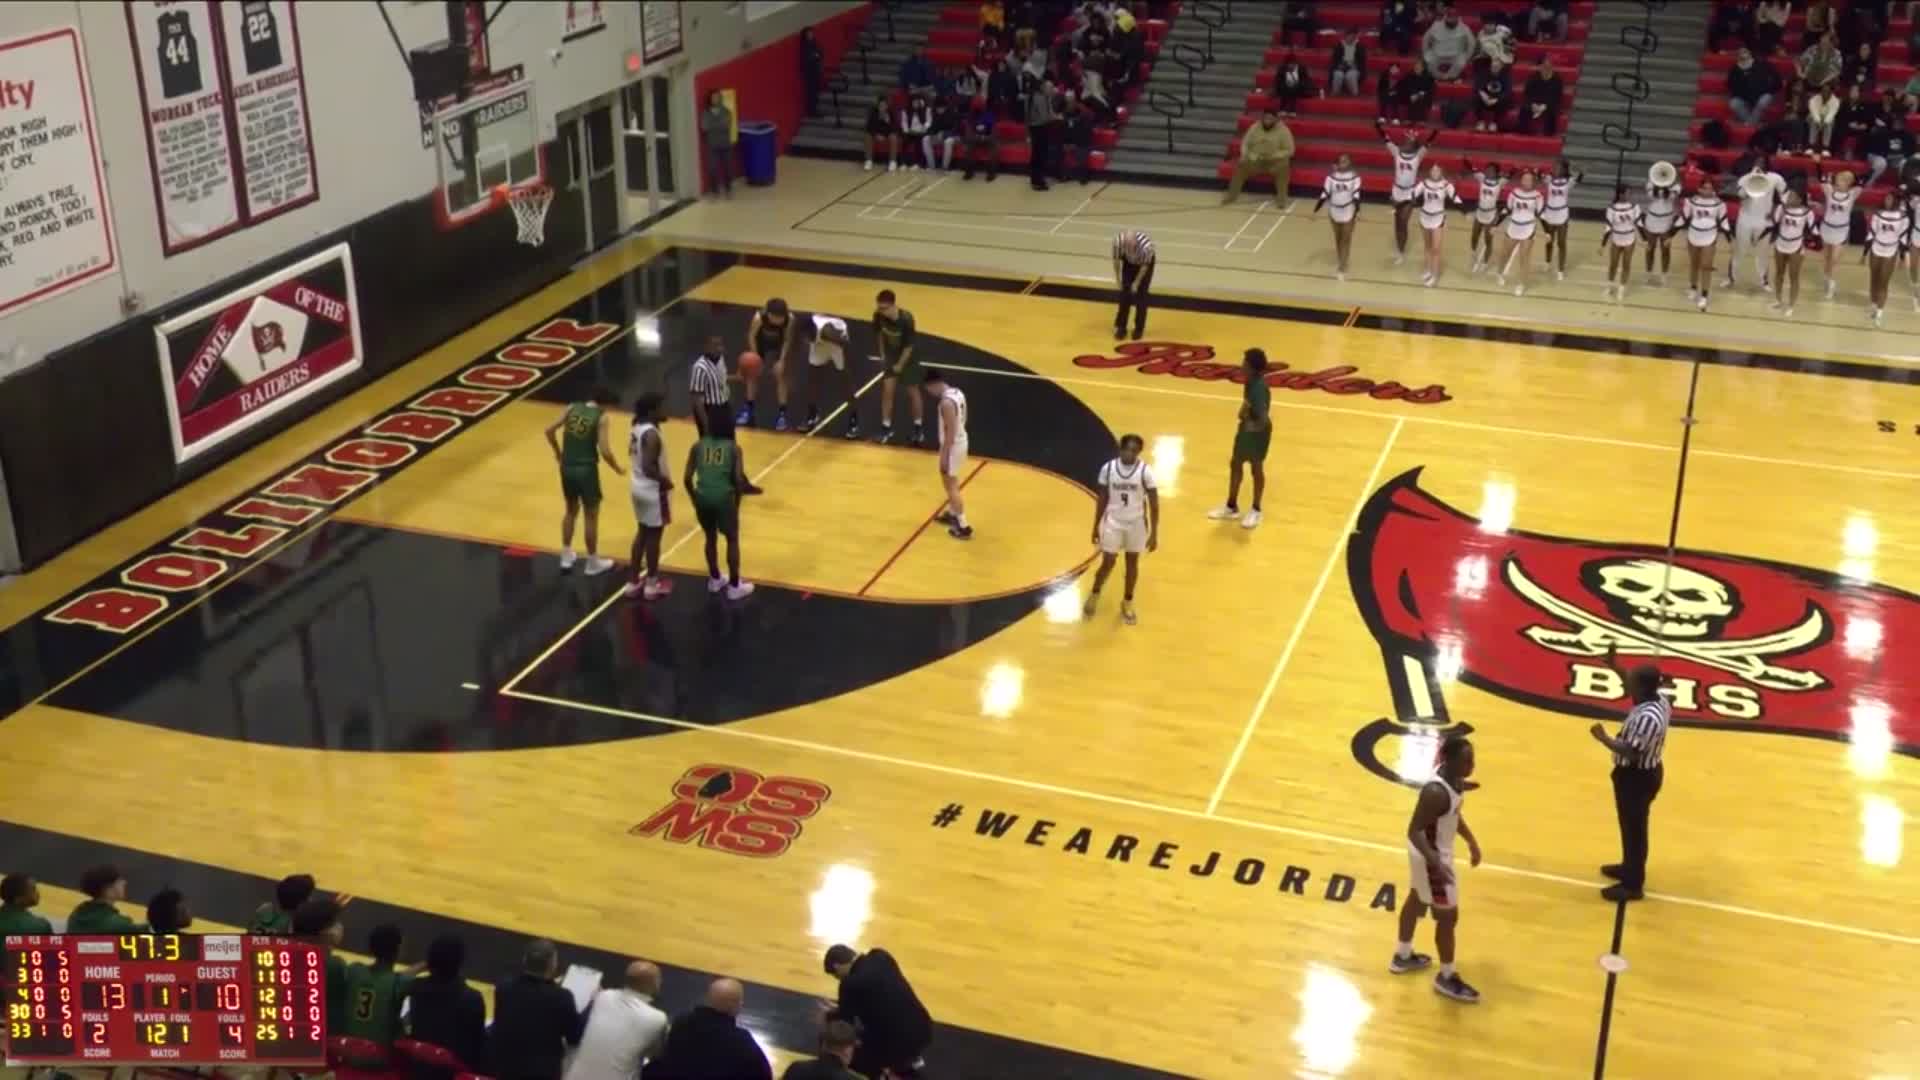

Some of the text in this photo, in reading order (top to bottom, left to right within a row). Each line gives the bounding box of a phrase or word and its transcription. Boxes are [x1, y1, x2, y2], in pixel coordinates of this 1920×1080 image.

[248, 12, 271, 43] 22
[166, 35, 190, 65] 44
[5, 194, 45, 217] ALWAYS
[19, 208, 57, 228] HONOR
[40, 221, 61, 237] AND
[64, 208, 95, 227] WHITE
[295, 286, 345, 322] OF THE
[188, 324, 232, 388] HOME
[240, 363, 310, 412] RAIDERS
[43, 318, 620, 635] BOLINGBROOK
[931, 803, 1396, 913] #WEAREJORDA
